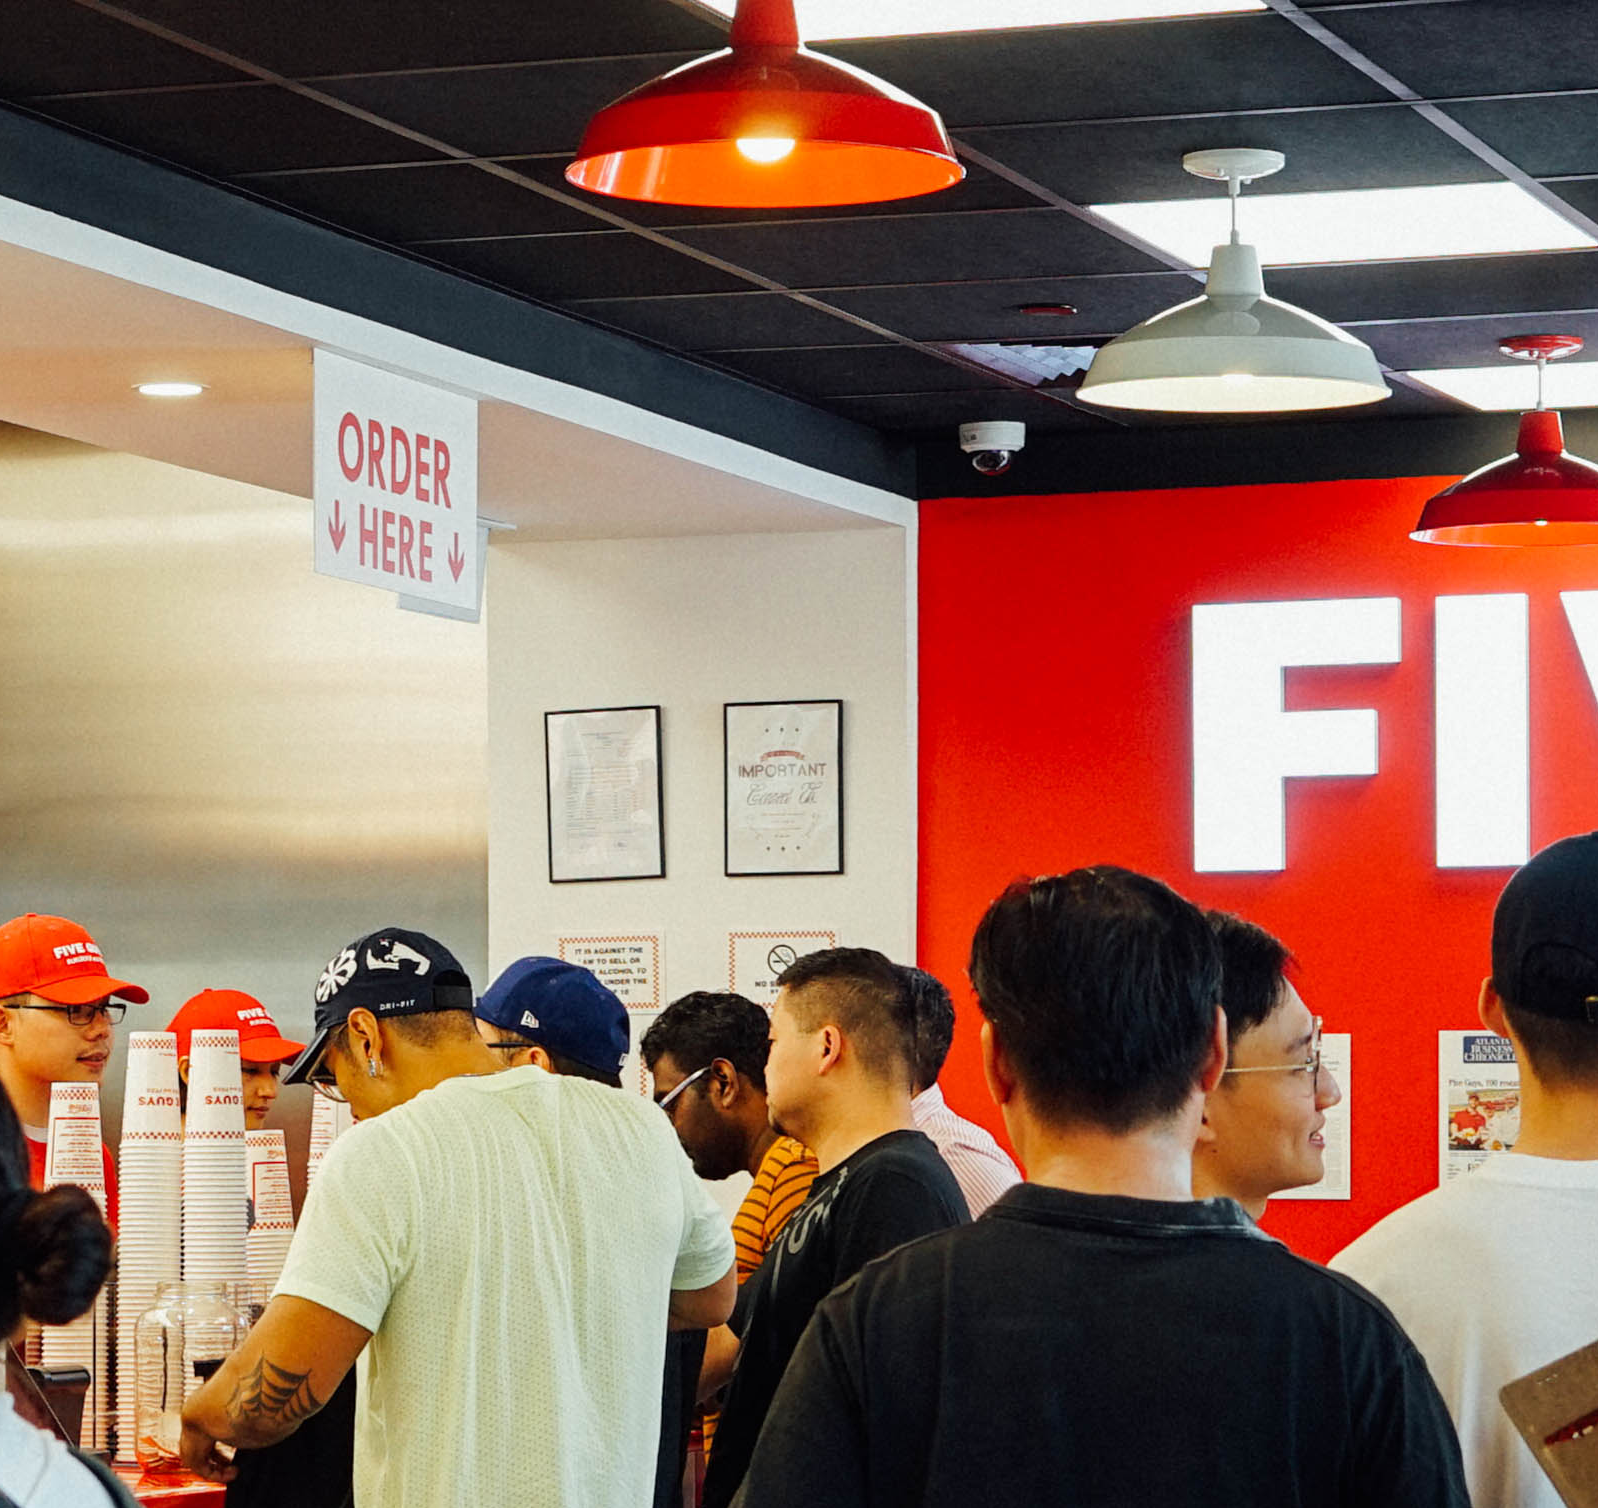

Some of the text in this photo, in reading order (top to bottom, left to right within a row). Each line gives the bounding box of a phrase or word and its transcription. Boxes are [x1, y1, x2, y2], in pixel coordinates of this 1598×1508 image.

[338, 411, 451, 509] ORDER
[359, 504, 433, 583] HERE
[738, 763, 827, 779] IMPORTANT
[53, 943, 84, 960] FIVE
[237, 1008, 263, 1021] FIVE
